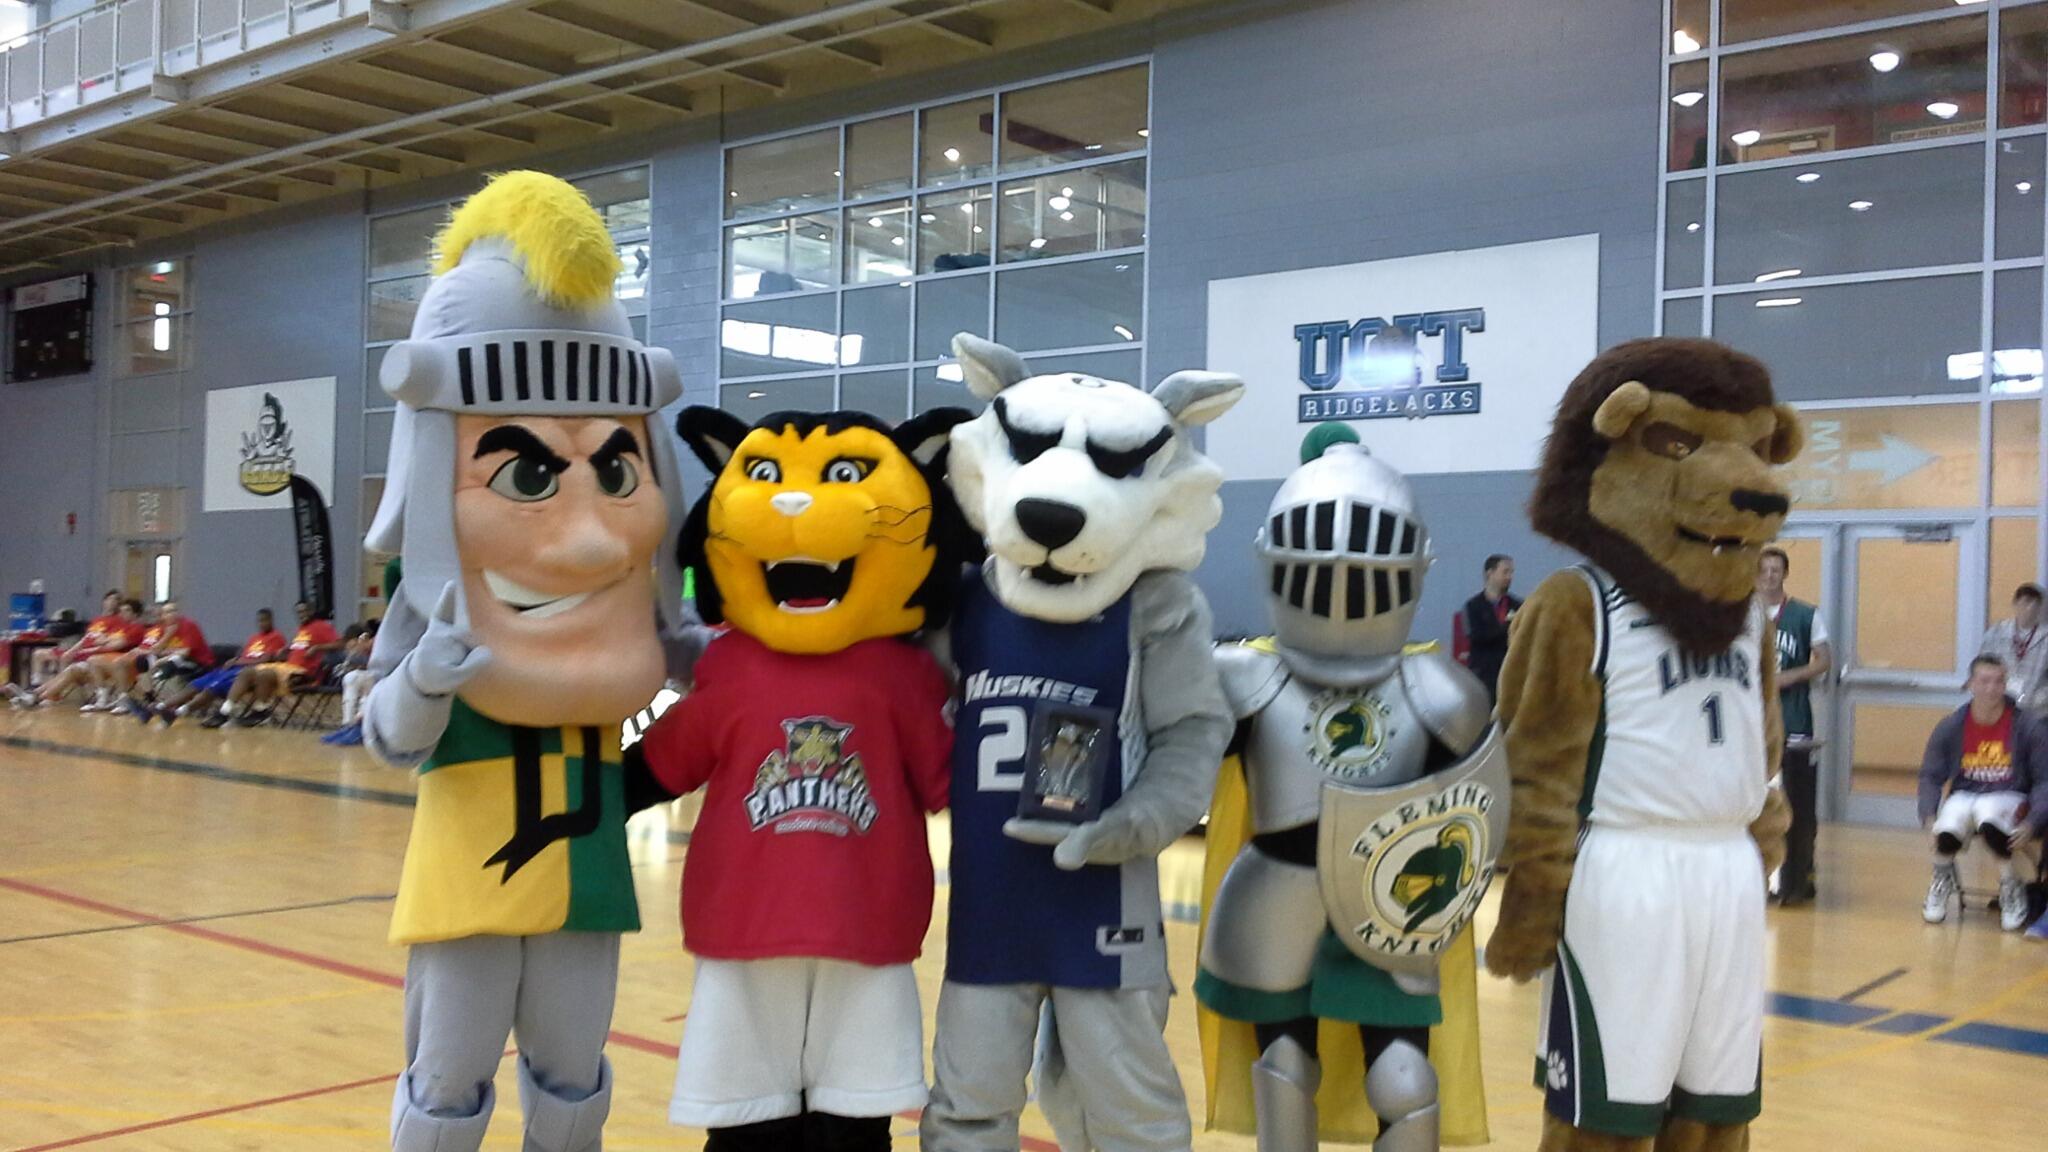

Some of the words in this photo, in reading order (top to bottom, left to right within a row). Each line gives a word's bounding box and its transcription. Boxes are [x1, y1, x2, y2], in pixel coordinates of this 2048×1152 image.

[1305, 391, 1474, 417] RIDGEBACKS
[1702, 692, 1724, 746] 1
[977, 705, 1028, 792] 2
[747, 776, 877, 833] PANTHERS
[1354, 785, 1491, 858] FLEMING
